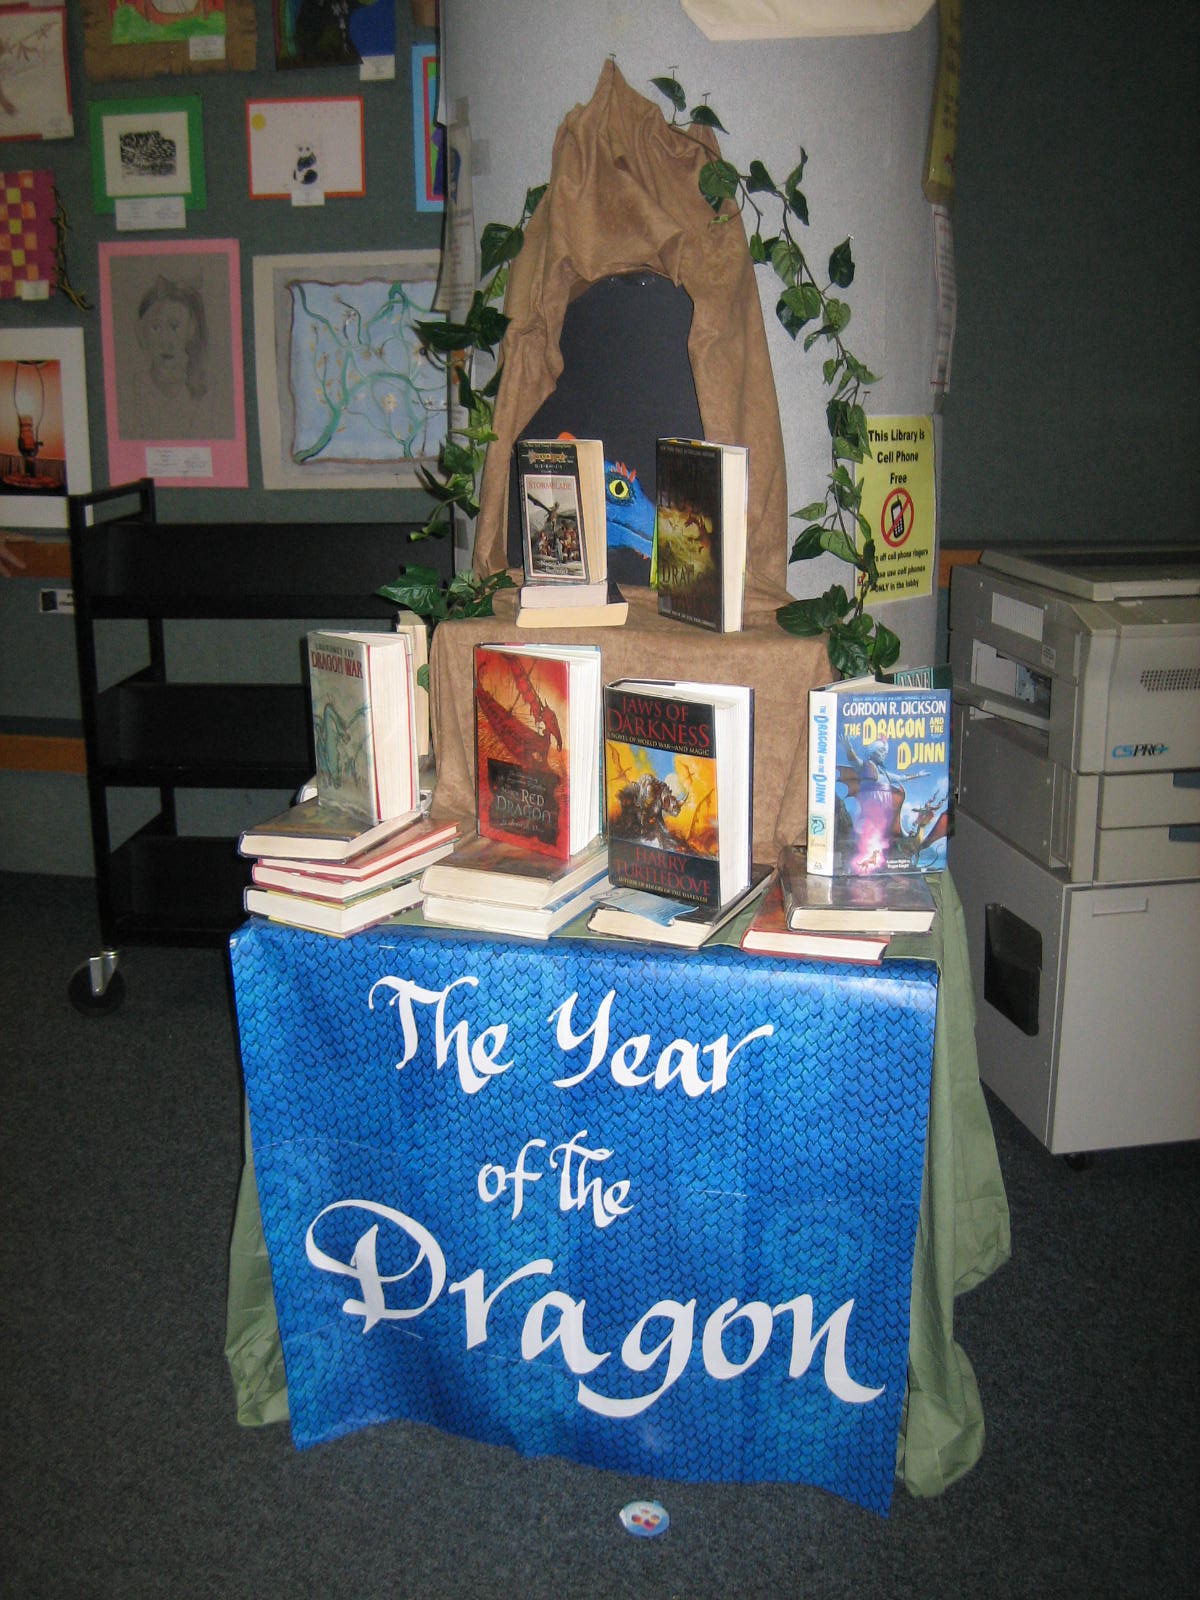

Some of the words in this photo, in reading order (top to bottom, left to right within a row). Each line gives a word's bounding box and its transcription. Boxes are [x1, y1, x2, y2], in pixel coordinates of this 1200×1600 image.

[868, 429, 888, 442] This
[890, 429, 918, 443] Library
[877, 451, 894, 463] Cell
[895, 450, 919, 463] Phone
[890, 472, 908, 485] Free
[897, 550, 912, 560] phone
[622, 695, 662, 718] JAWS
[666, 703, 689, 722] OF
[842, 701, 888, 716] GORDON
[889, 701, 900, 715] R.
[901, 700, 947, 715] DICKSON
[929, 717, 945, 725] AND
[607, 707, 710, 749] DARKNESS
[813, 714, 829, 755] DRAGON
[844, 723, 861, 737] THE
[862, 716, 926, 747] DRAGON
[929, 725, 945, 734] THE
[612, 733, 628, 742] NOVEL
[637, 736, 658, 746] WORLD
[689, 746, 711, 756] MAGIC
[897, 741, 946, 771] DJINN
[521, 788, 545, 808] RED
[812, 774, 828, 805] DJINN
[497, 795, 551, 823] DRAGON
[635, 847, 688, 874] HARRY
[615, 859, 710, 897] TURTLEDOVE
[368, 975, 513, 1094] The
[547, 989, 774, 1097] Year
[478, 1138, 546, 1220] of
[305, 1199, 886, 1417] Dragon
